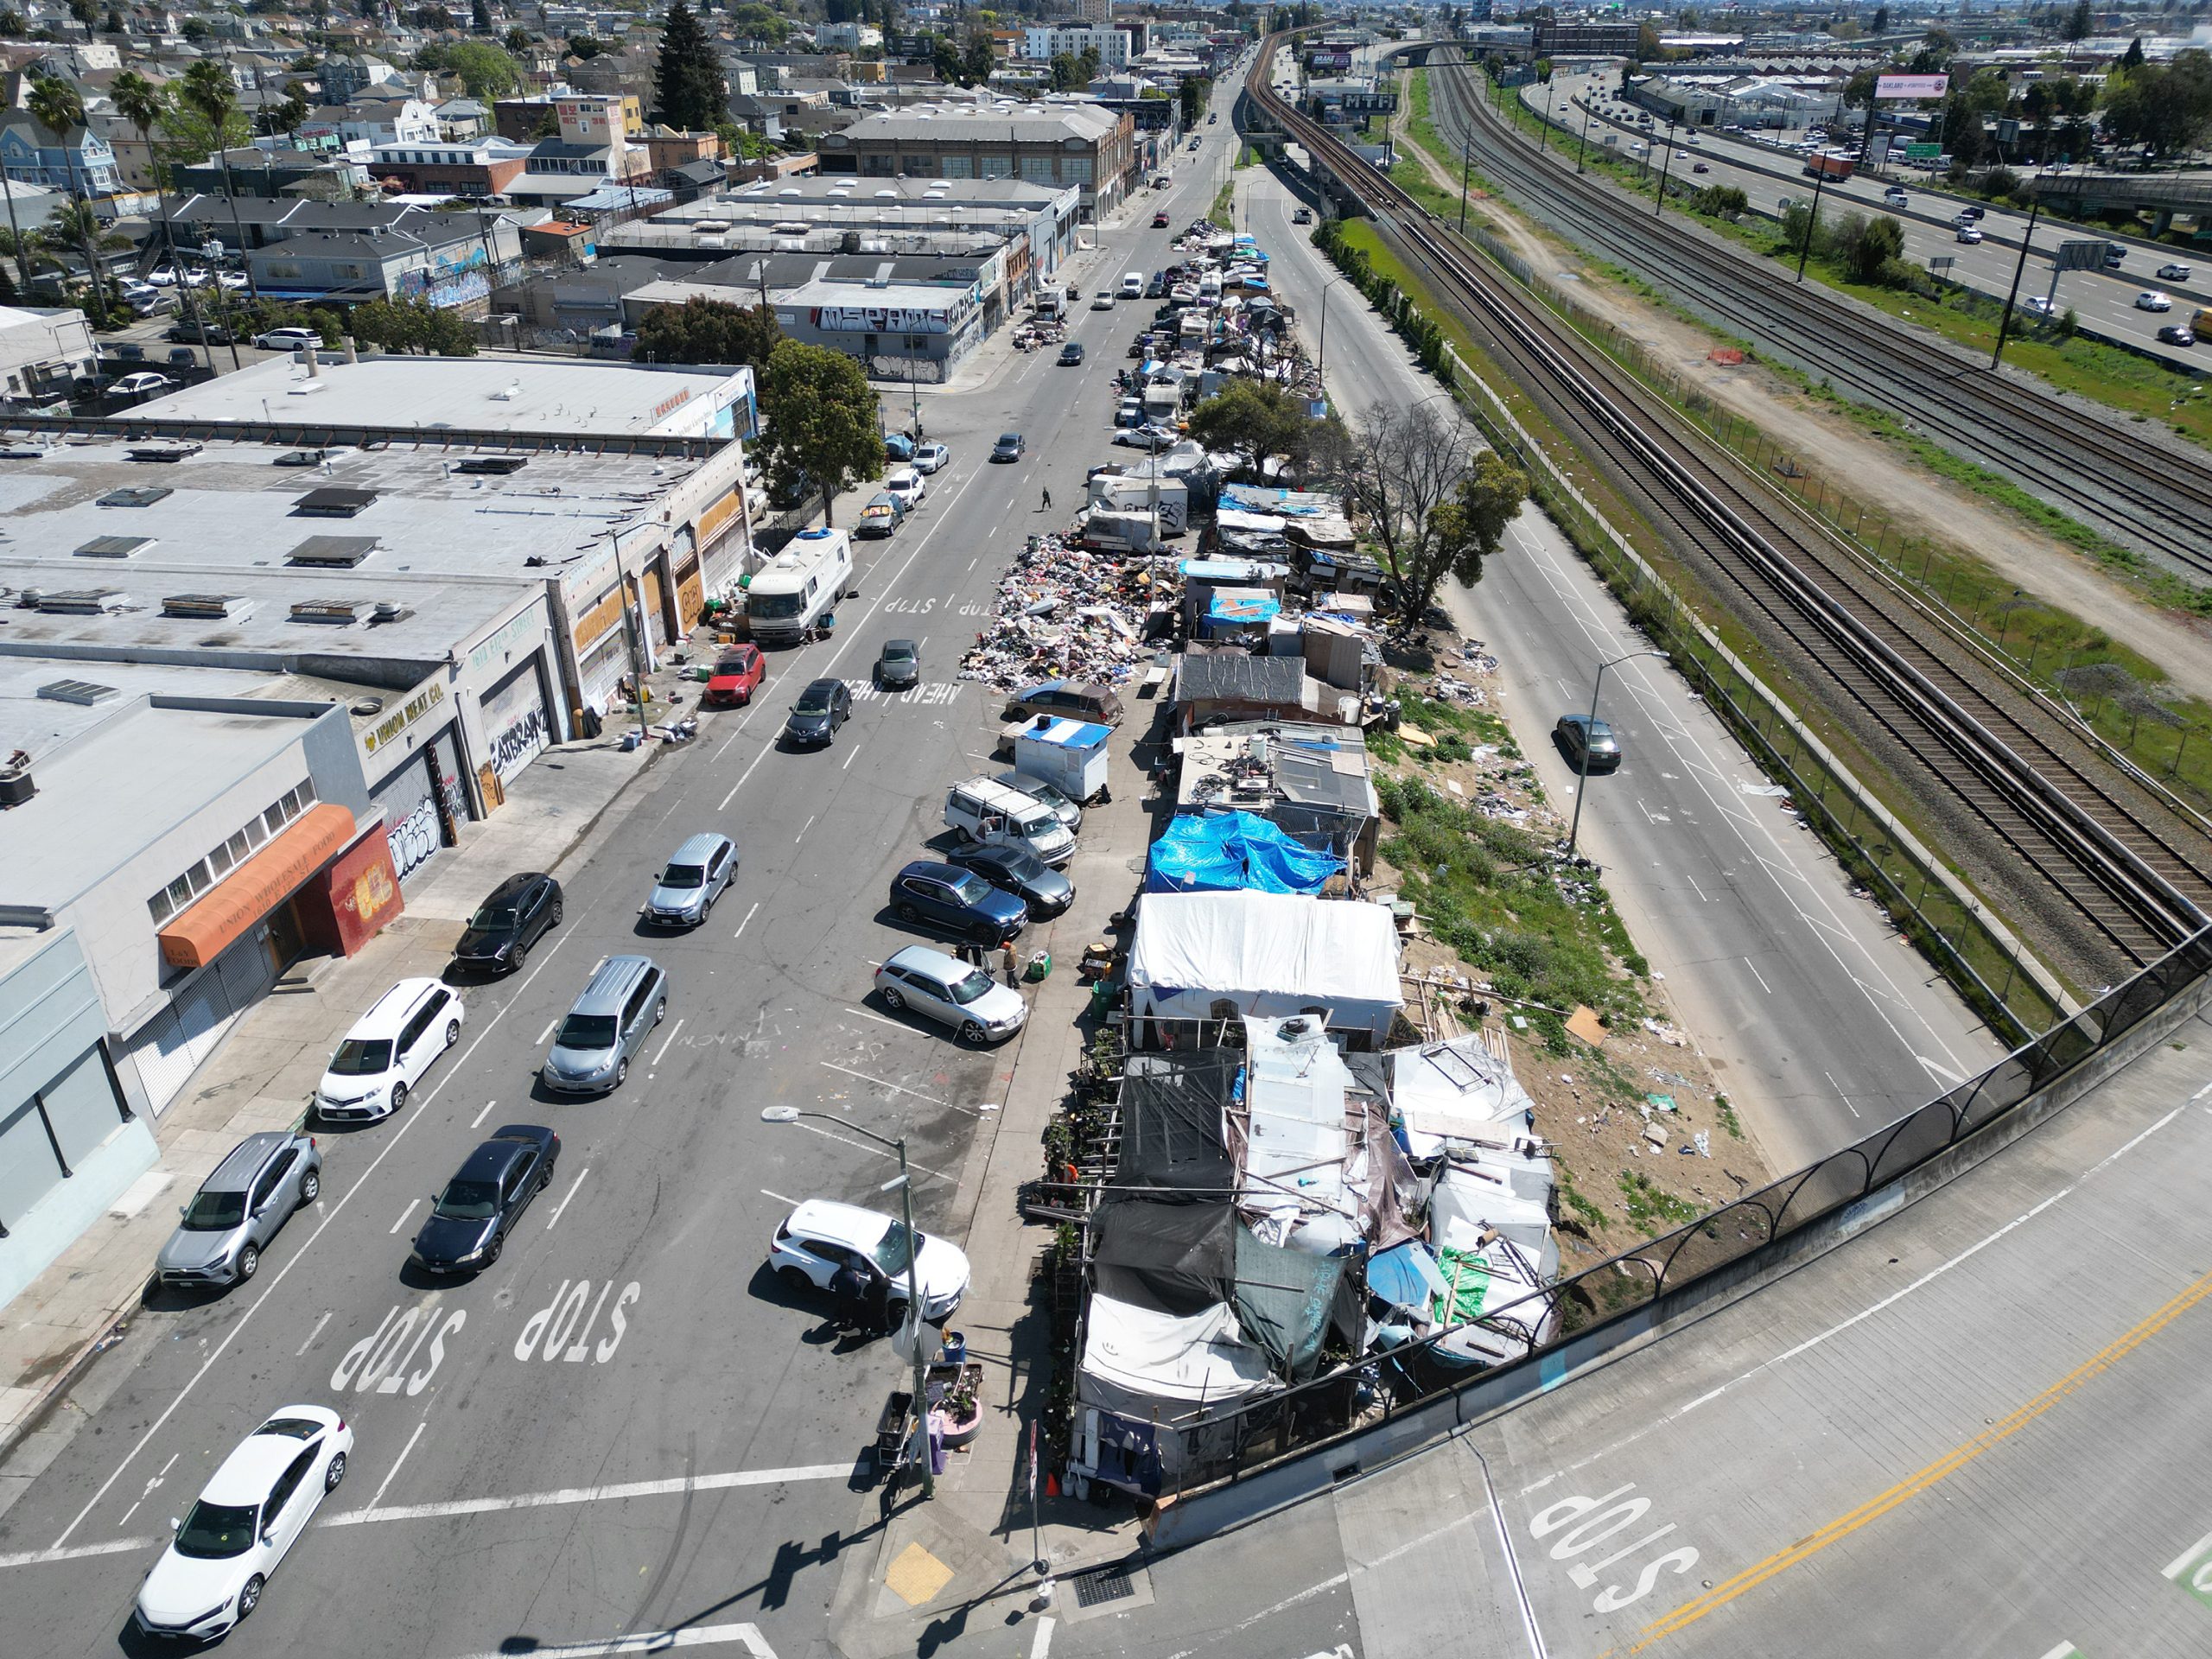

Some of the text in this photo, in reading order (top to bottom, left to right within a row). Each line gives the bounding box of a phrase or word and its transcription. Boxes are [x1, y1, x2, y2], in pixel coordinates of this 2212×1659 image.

[1314, 55, 1335, 65] DRAKE
[511, 608, 535, 639] STREET
[884, 597, 937, 614] STOP
[959, 600, 995, 616] TOP
[376, 682, 444, 745] UNION MEAT CO.
[219, 831, 336, 934] UNION WHOLESALE FOOD
[330, 1305, 467, 1396] STOP
[513, 1280, 640, 1363] STOP
[1529, 1482, 1700, 1613] STOP
